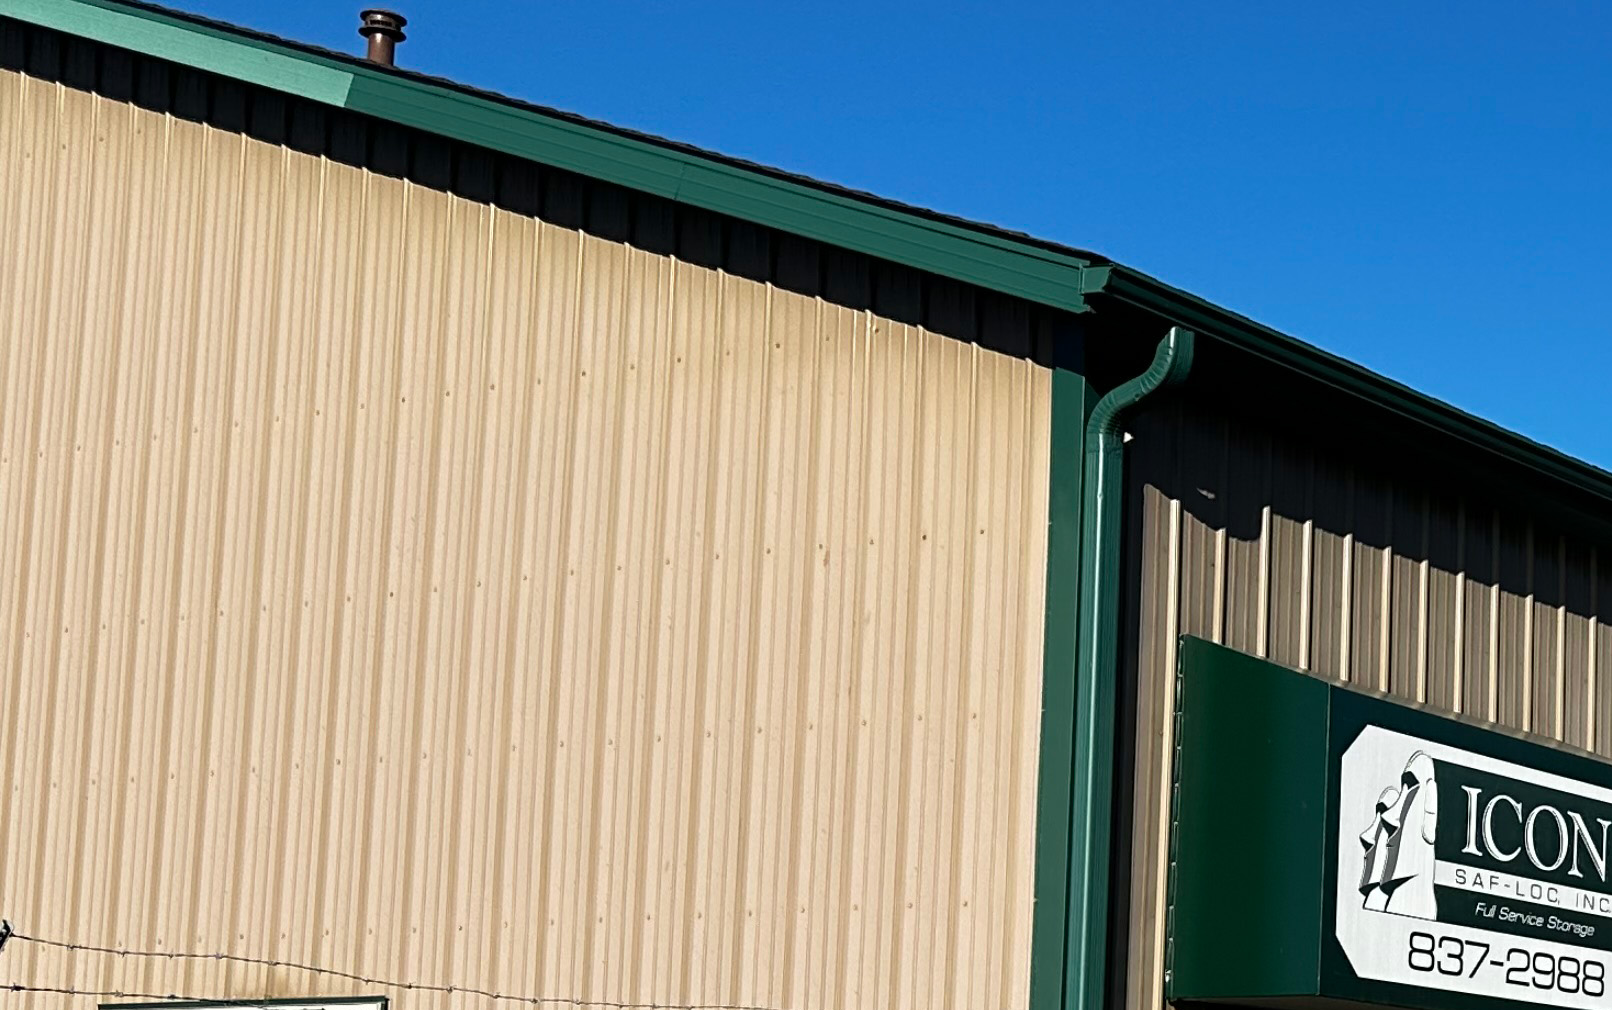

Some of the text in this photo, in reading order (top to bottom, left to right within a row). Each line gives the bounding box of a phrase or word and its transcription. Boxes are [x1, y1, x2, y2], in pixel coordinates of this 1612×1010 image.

[1461, 785, 1612, 883] ICON
[1475, 902, 1596, 938] Full Service Storage
[1408, 931, 1605, 997] 837-2988
